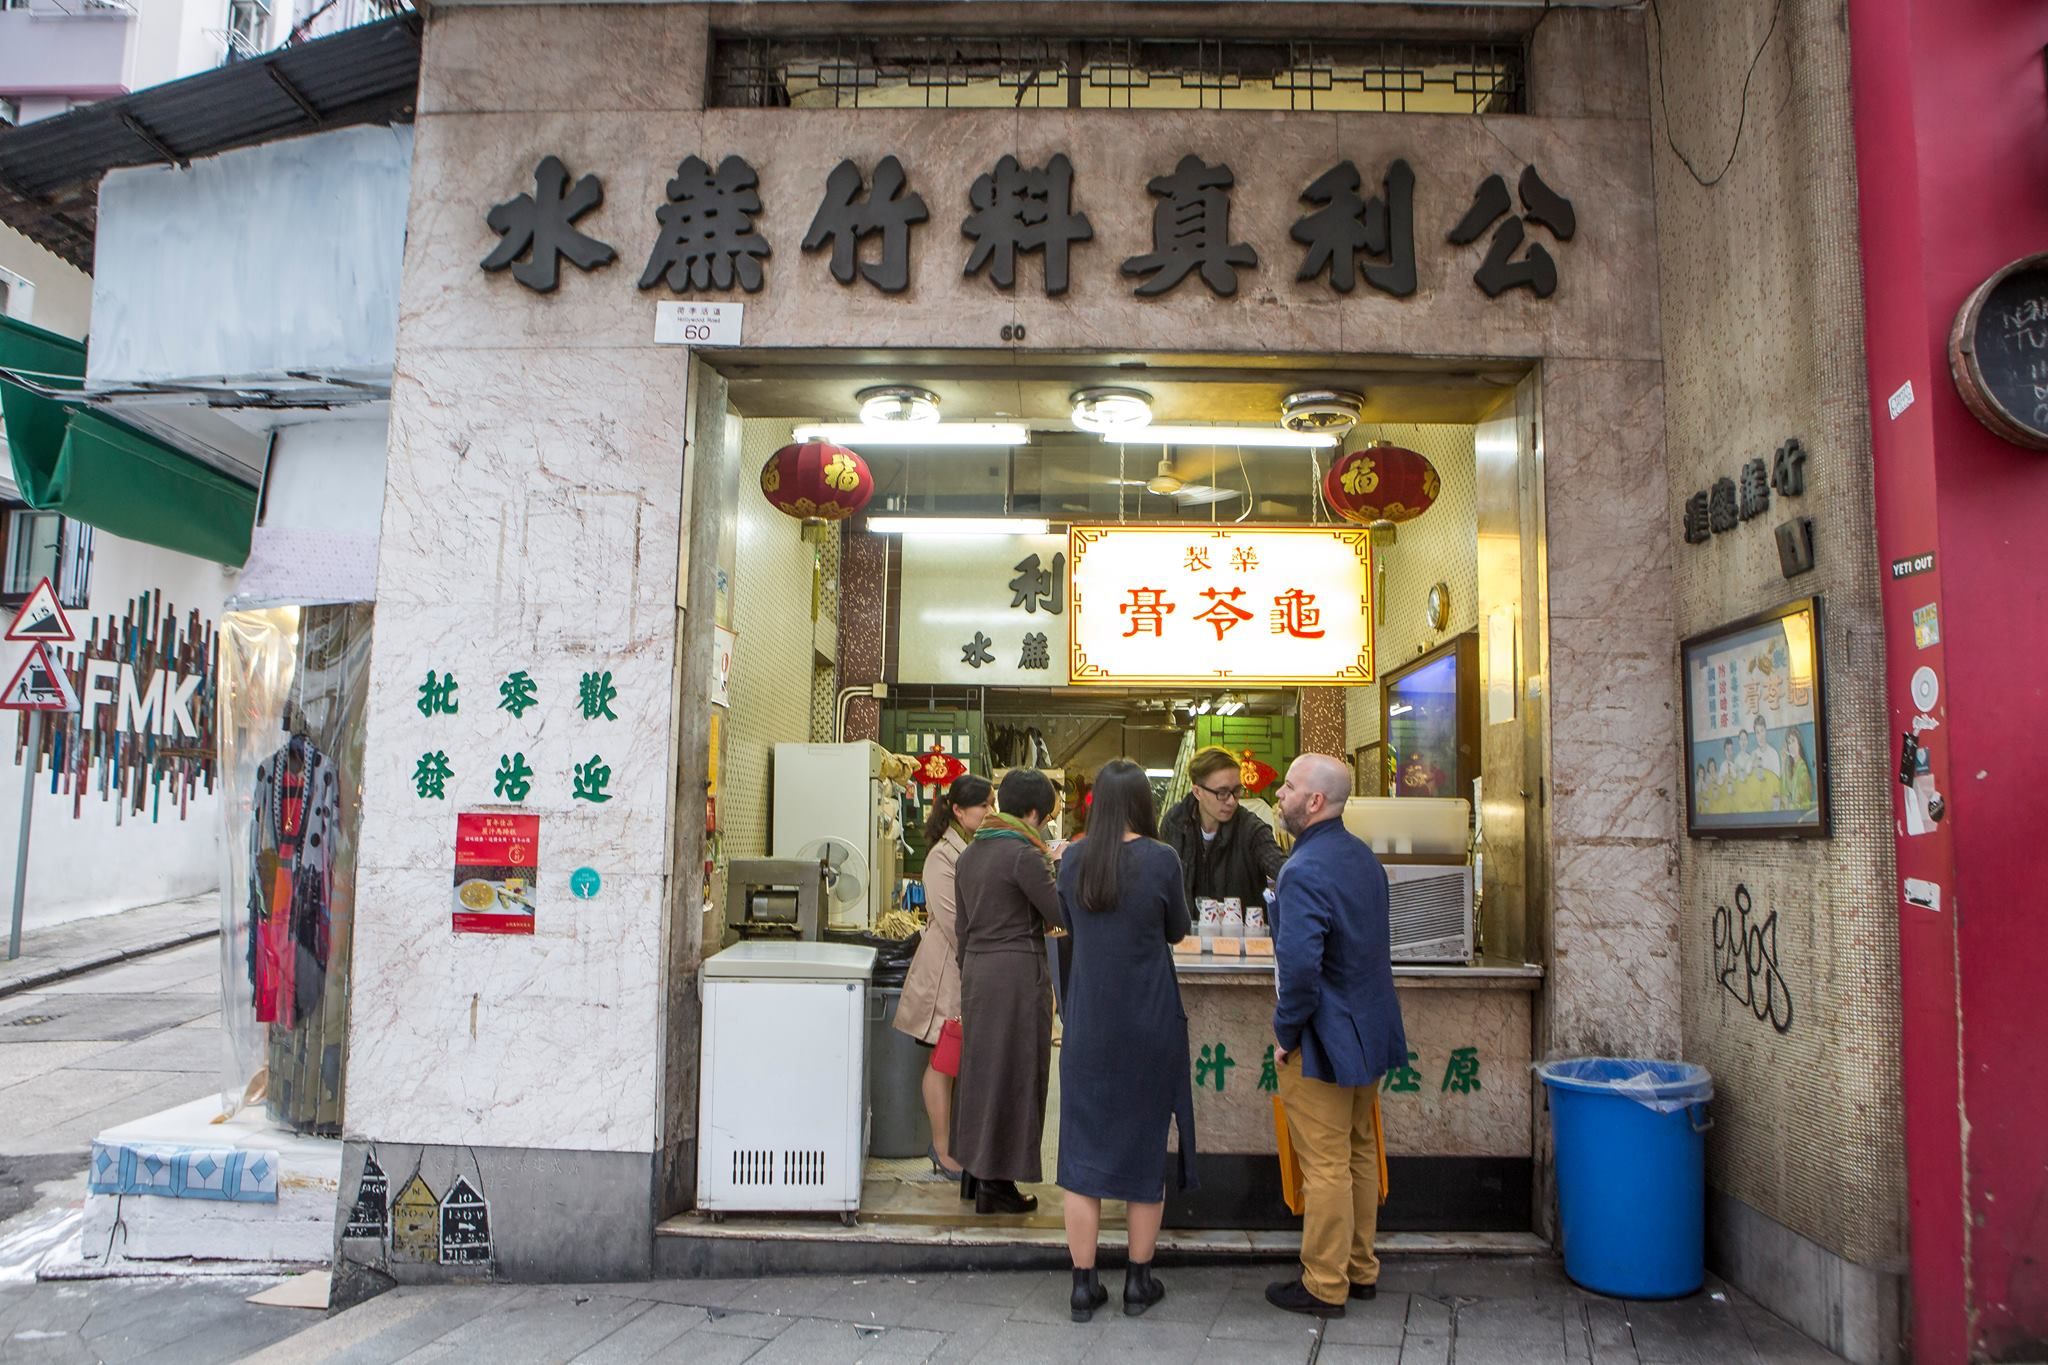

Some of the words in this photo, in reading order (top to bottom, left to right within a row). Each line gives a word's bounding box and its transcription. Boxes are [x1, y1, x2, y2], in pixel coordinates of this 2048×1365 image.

[684, 324, 711, 341] 60
[1000, 324, 1026, 341] 60
[1893, 560, 1912, 577] YETI
[1914, 555, 1934, 572] OUT
[1009, 551, 1066, 615] 利
[31, 605, 50, 622] 1:5
[1119, 586, 1326, 642] 龜苓膏
[82, 658, 205, 739] FMK
